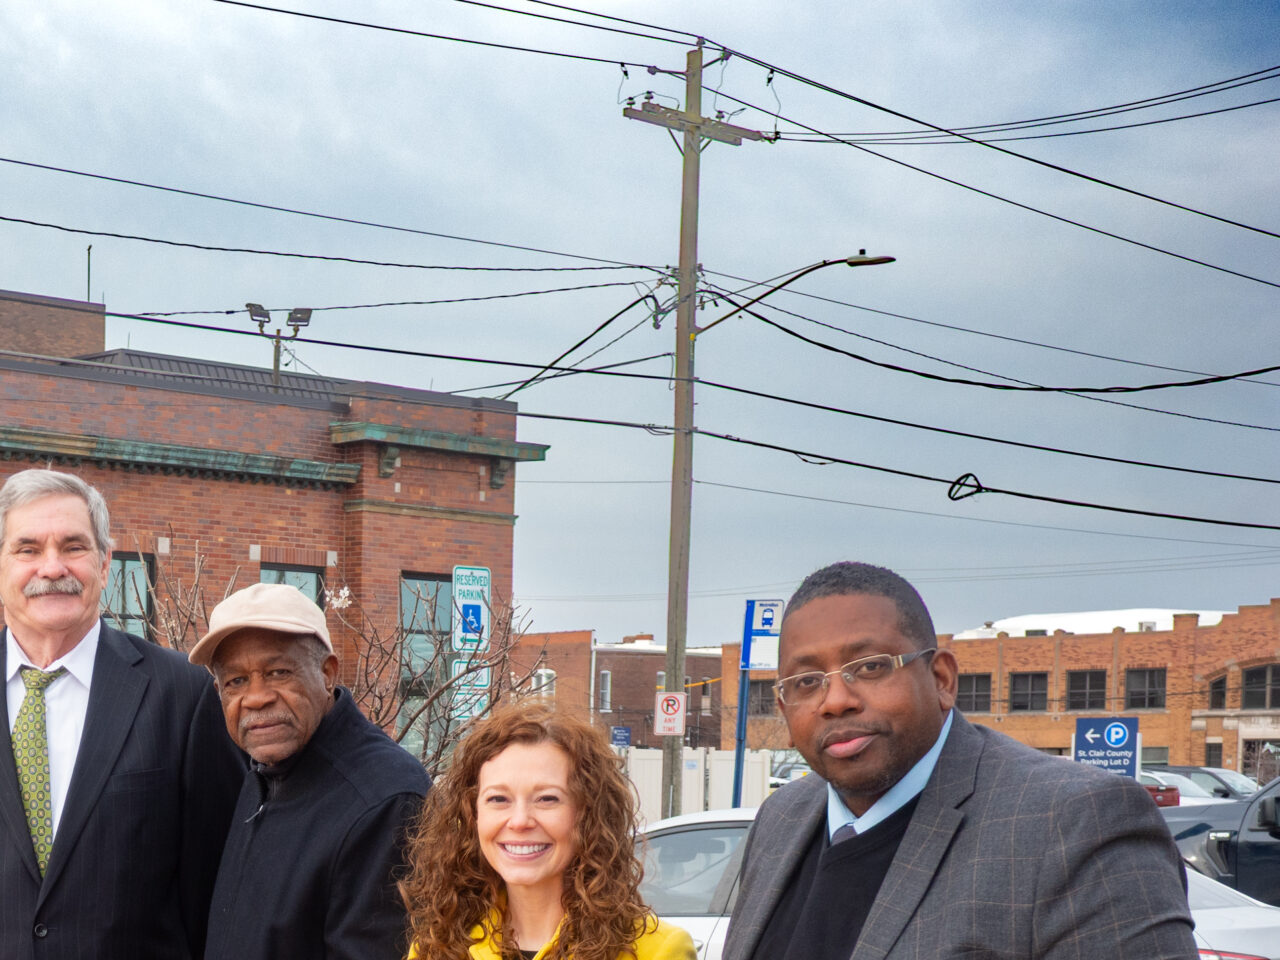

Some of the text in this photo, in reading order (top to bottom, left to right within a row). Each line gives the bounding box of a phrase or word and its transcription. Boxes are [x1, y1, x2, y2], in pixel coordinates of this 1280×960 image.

[456, 574, 488, 587] RESERVED
[1088, 749, 1105, 757] Clair
[1106, 750, 1133, 759] County
[1080, 758, 1130, 767] Parking Lot D
